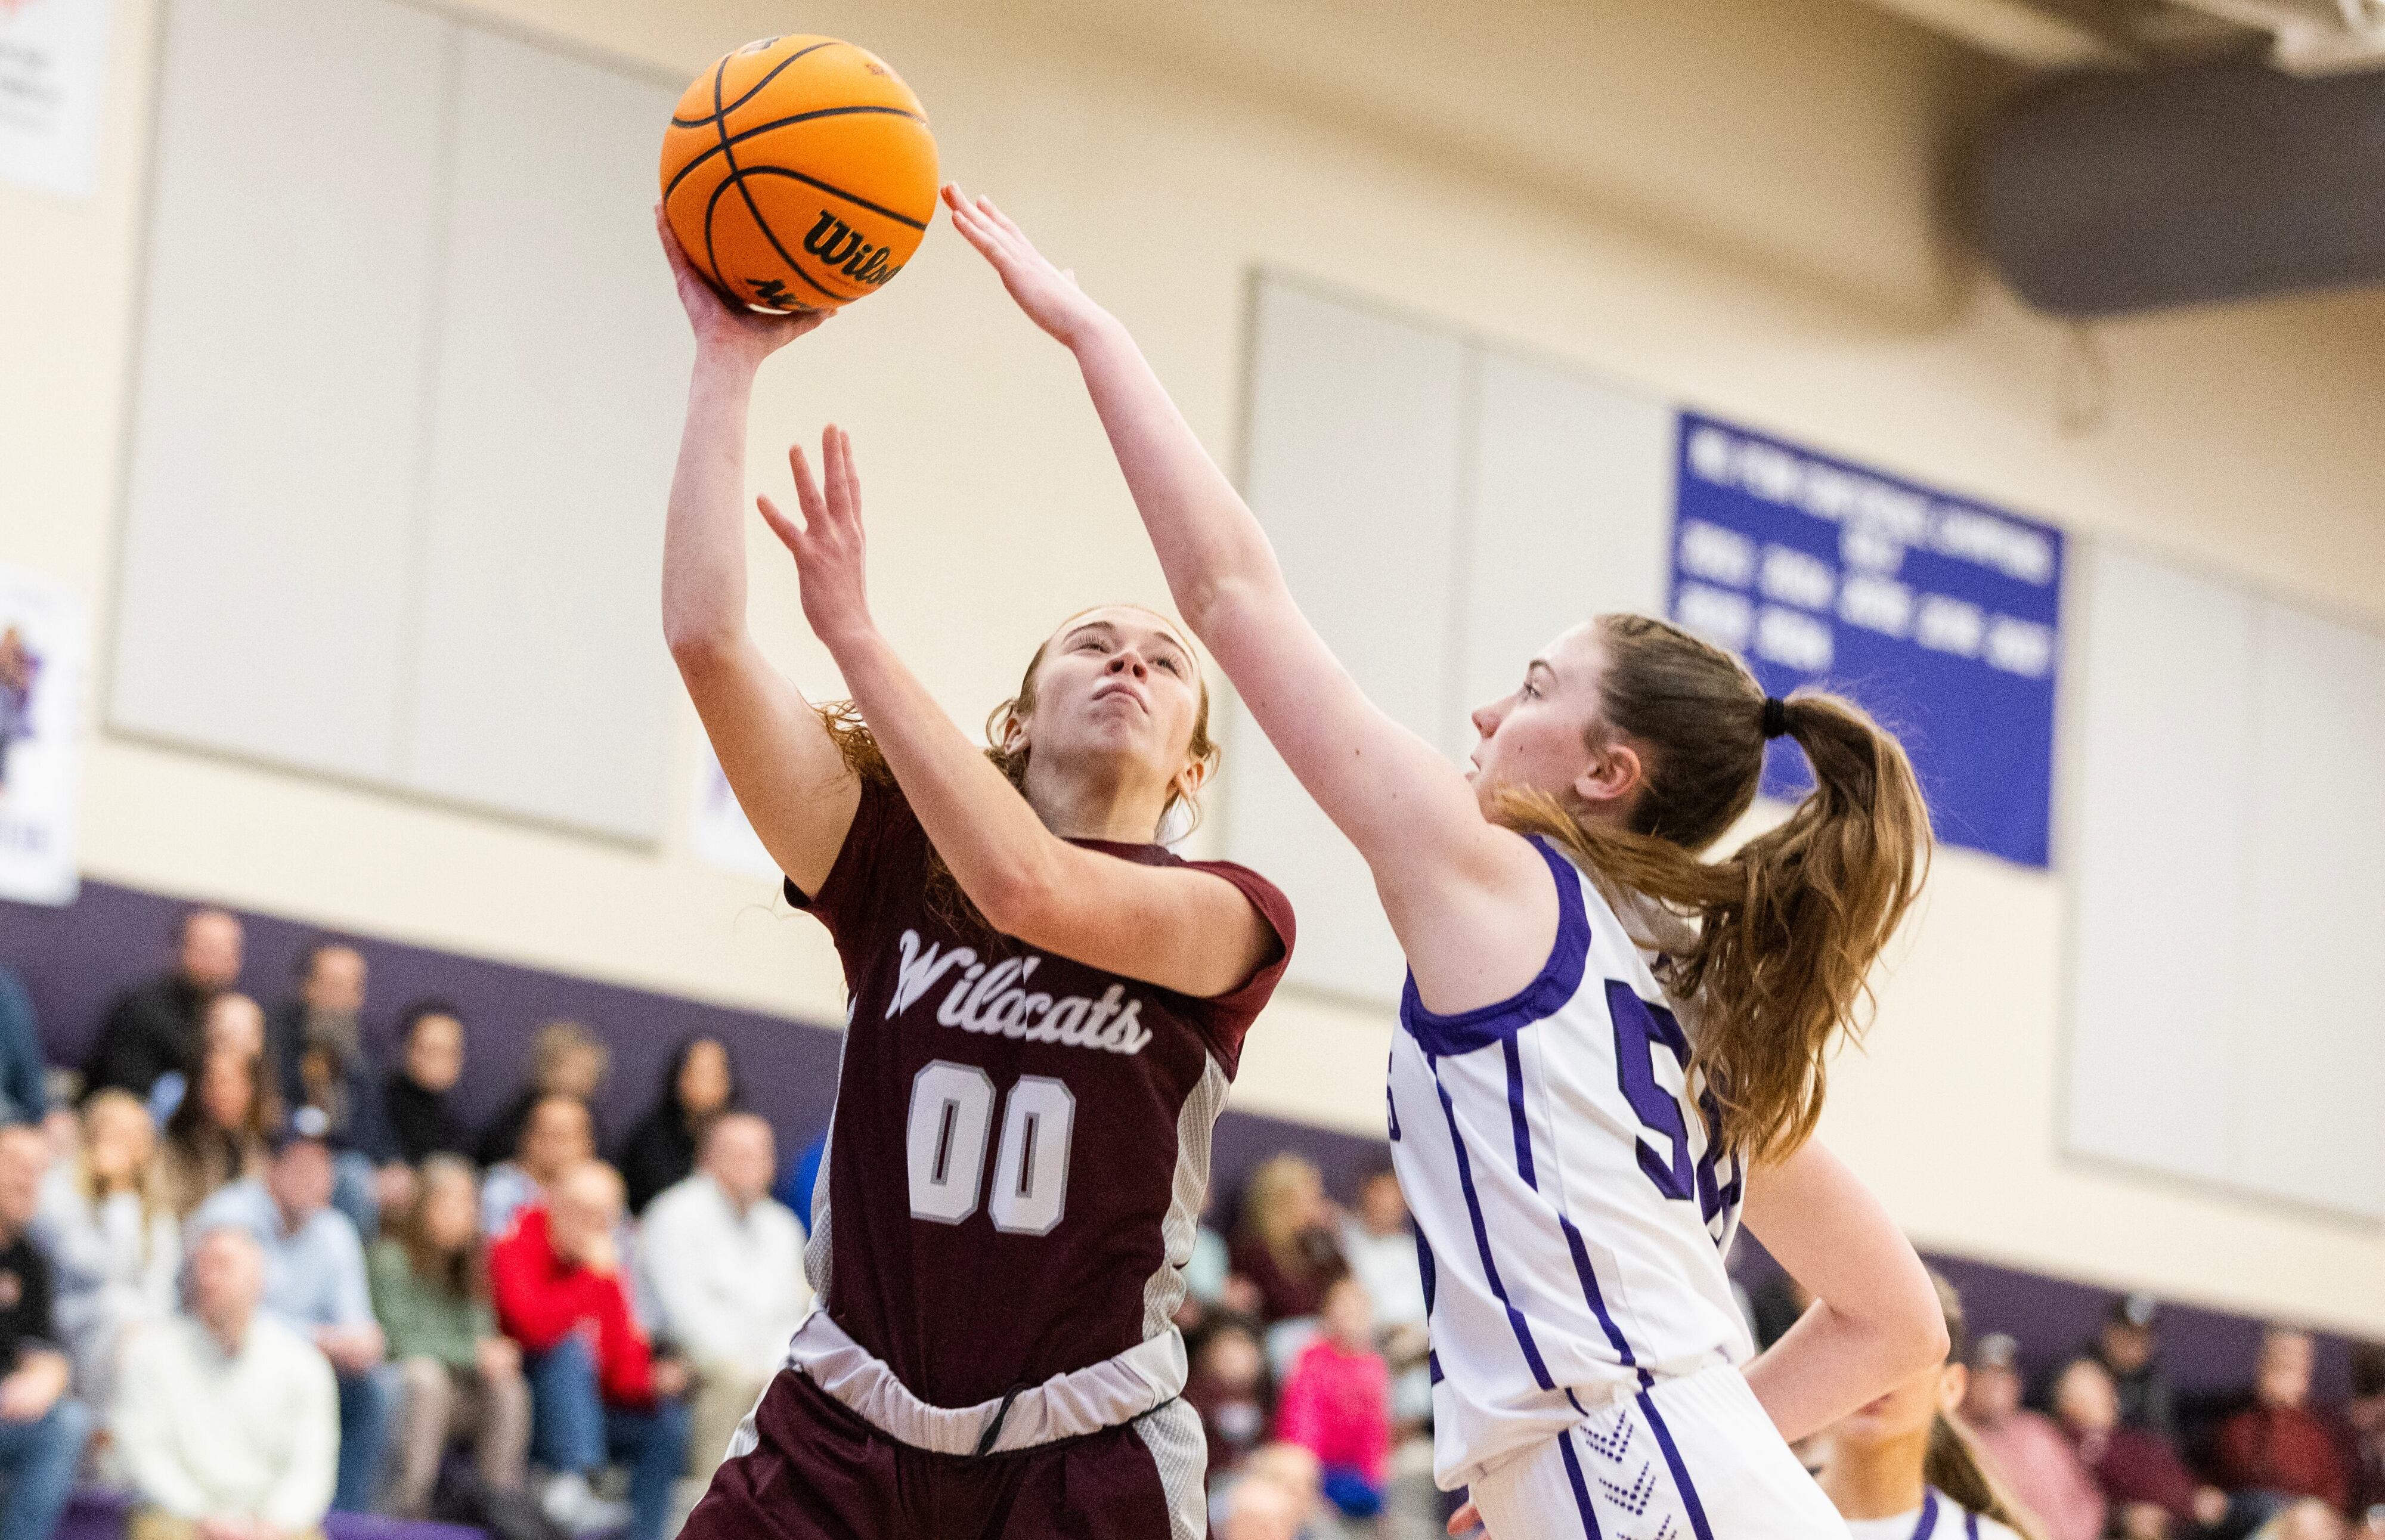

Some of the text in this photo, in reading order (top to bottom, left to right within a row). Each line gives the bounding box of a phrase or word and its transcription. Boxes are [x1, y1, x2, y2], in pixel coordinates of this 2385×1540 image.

[803, 209, 903, 286] Wilso
[885, 928, 1153, 1055] Wildcats
[906, 1058, 1076, 1237] 00
